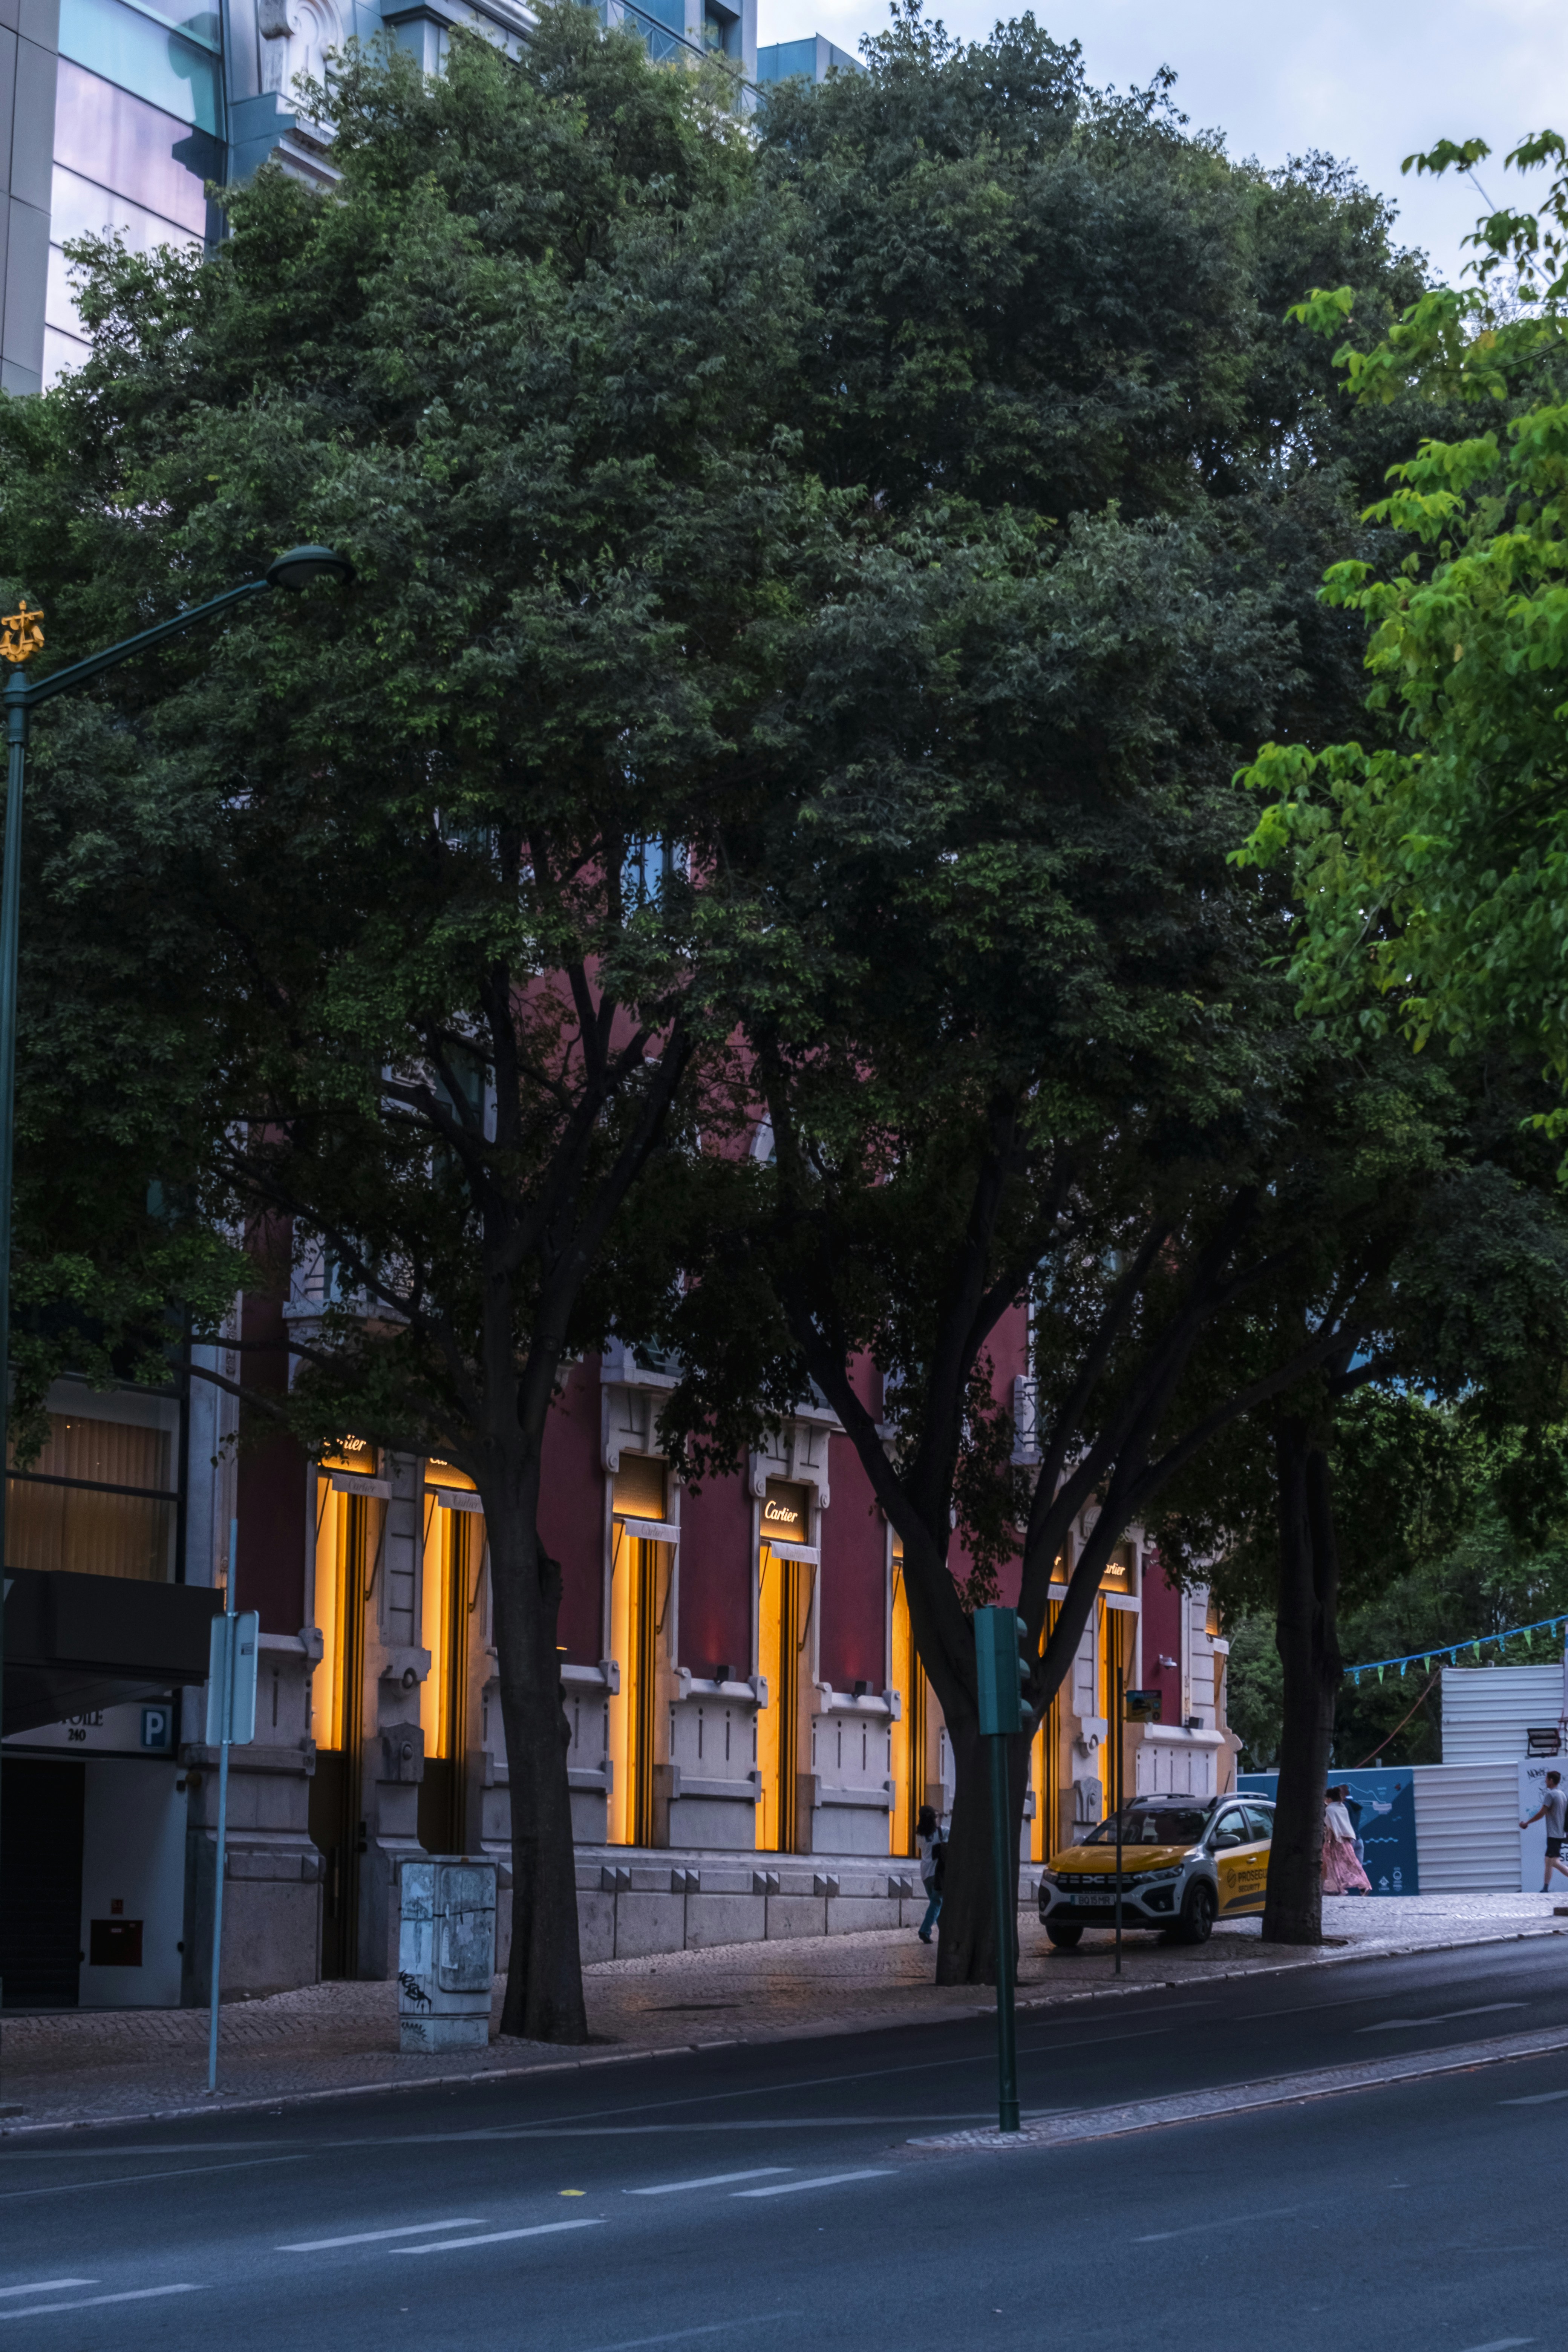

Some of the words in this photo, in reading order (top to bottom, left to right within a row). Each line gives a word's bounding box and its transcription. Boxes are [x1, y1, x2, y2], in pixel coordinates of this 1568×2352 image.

[764, 1500, 798, 1523] Cartier
[1104, 1562, 1126, 1576] artier
[61, 1710, 103, 1726] OILE
[68, 1729, 86, 1741] 240
[146, 1712, 164, 1745] P
[1238, 1869, 1267, 1882] PROSEGU
